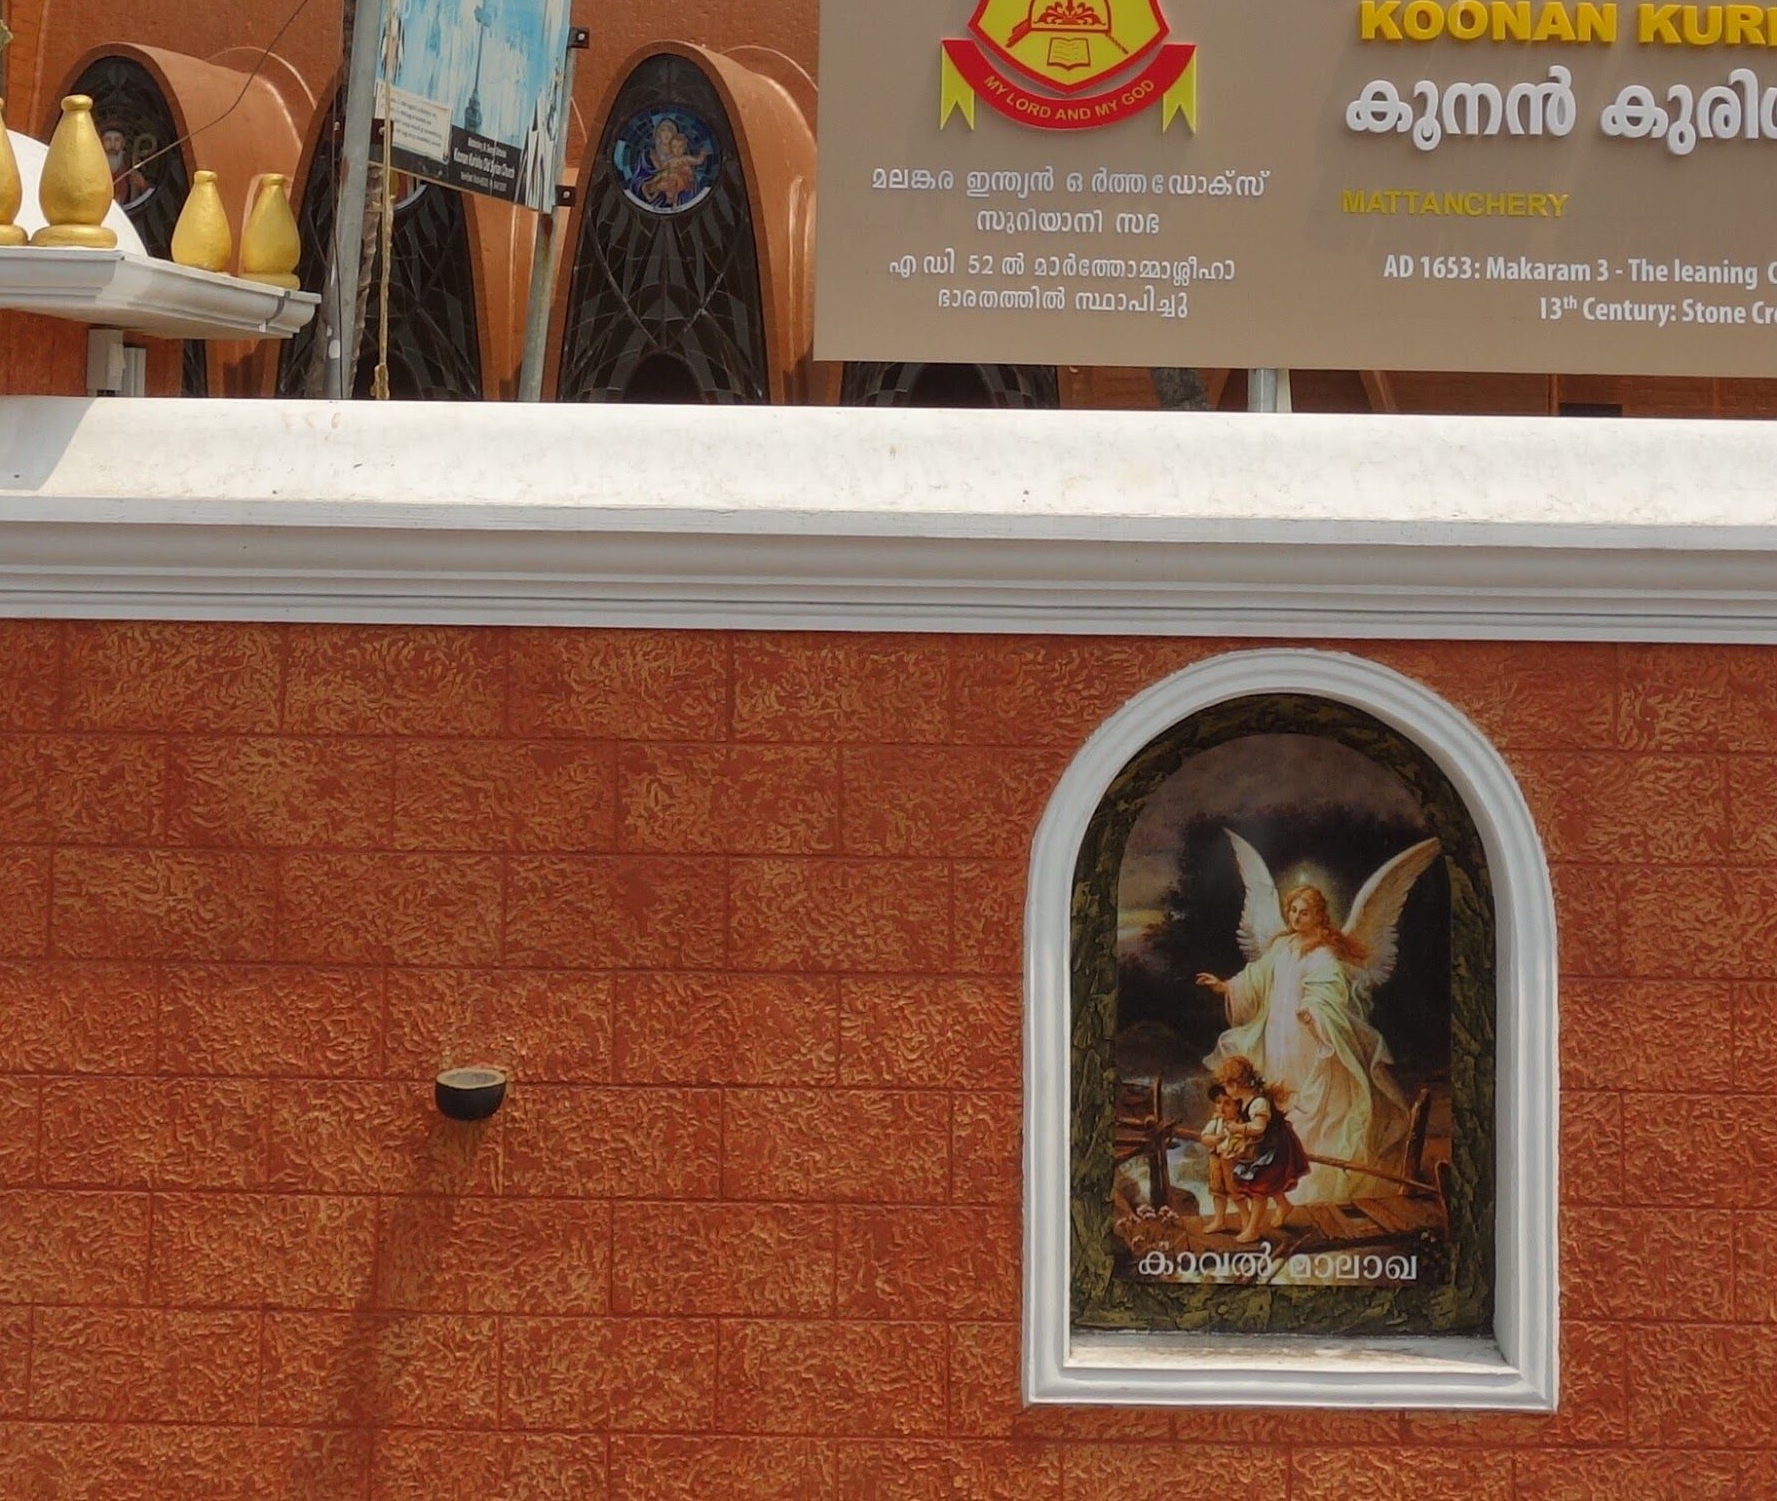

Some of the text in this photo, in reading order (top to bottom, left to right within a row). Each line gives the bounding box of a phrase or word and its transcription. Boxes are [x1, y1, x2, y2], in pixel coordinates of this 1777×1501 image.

[1359, 0, 1619, 43] KOONAN
[983, 75, 1155, 121] MY LORD AND MY GOD
[1345, 65, 1576, 151] കൂനൻ
[1341, 189, 1568, 218] MATTANCHERY
[1115, 210, 1160, 235] സഭ
[967, 254, 993, 275] 52
[1384, 254, 1414, 280] AD
[1420, 255, 1481, 280] 1653:
[1486, 256, 1592, 283] Makaram
[1597, 258, 1610, 283] 3
[1629, 258, 1668, 284] The
[1674, 258, 1759, 290] leaning
[1583, 297, 1677, 329] Century:
[1682, 299, 1746, 325] Stone
[1138, 1242, 1418, 1281] കാവൽ മാലാഖ
